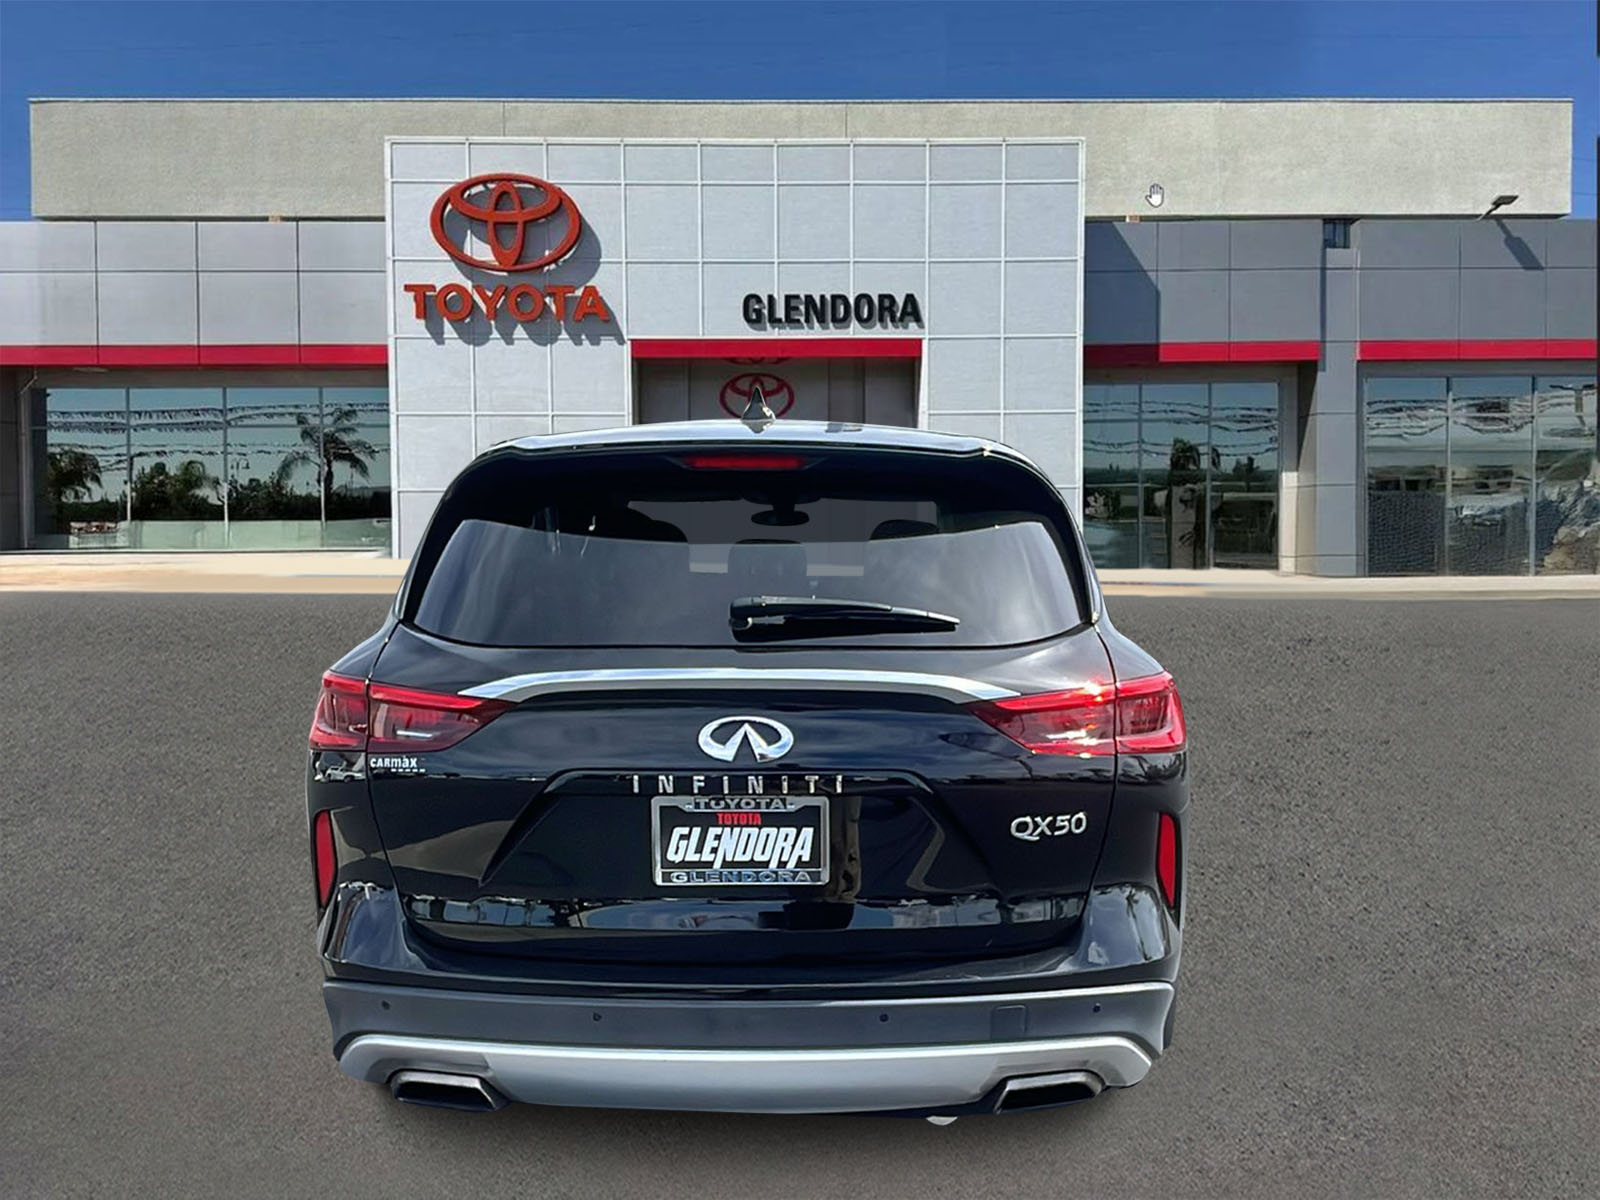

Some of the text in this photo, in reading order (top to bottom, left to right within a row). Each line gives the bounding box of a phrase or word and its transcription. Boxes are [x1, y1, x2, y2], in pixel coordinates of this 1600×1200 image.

[403, 283, 611, 323] TOYOTA
[742, 293, 923, 324] GLENDORA
[632, 775, 843, 794] INFINITI
[695, 798, 785, 810] TOYOTA
[716, 812, 762, 825] TOYOTA
[1010, 811, 1087, 841] QX50
[666, 826, 814, 869] GLENDORA
[670, 871, 812, 883] GLENDORA
